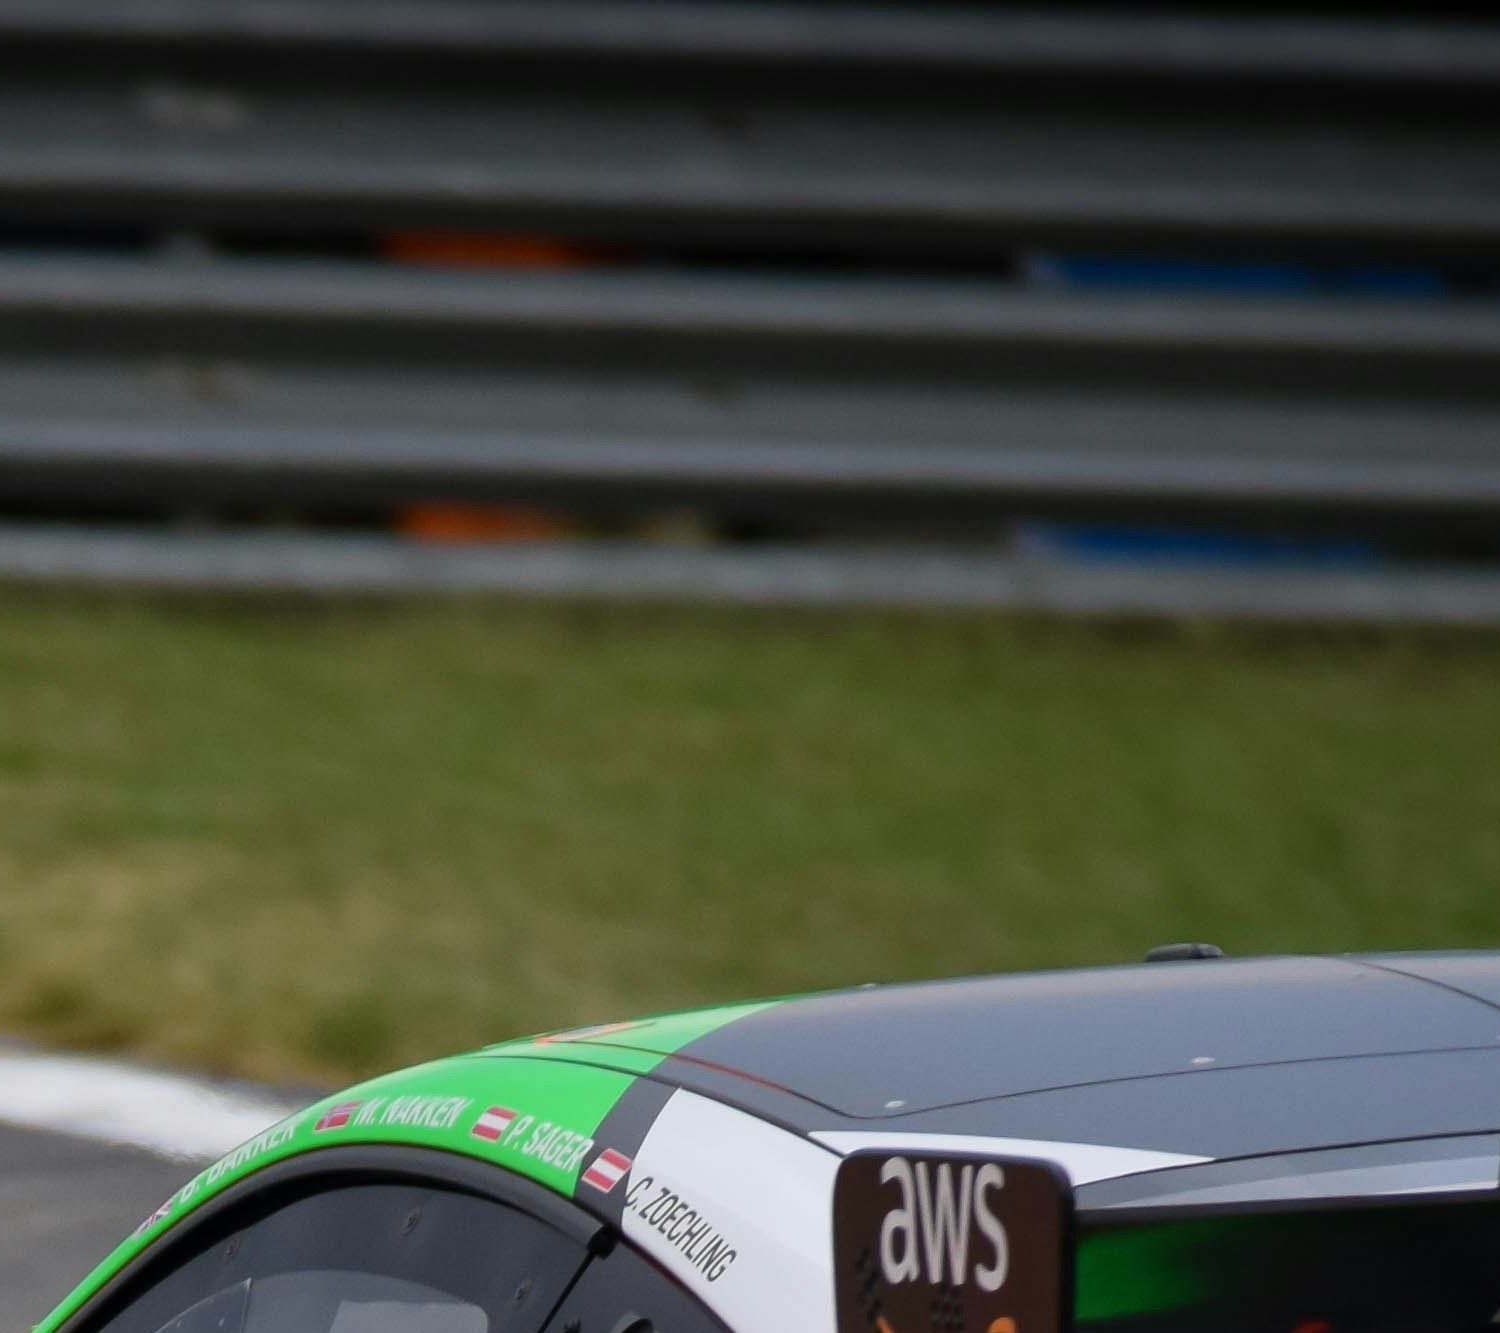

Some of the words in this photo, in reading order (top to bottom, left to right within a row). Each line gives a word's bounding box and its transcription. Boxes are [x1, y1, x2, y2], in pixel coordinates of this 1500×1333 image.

[503, 1115, 535, 1150] P.
[524, 1121, 595, 1172] SAGER
[625, 1176, 654, 1211] C.
[880, 1156, 1008, 1292] aws
[637, 1187, 737, 1282] ZOECHLING
